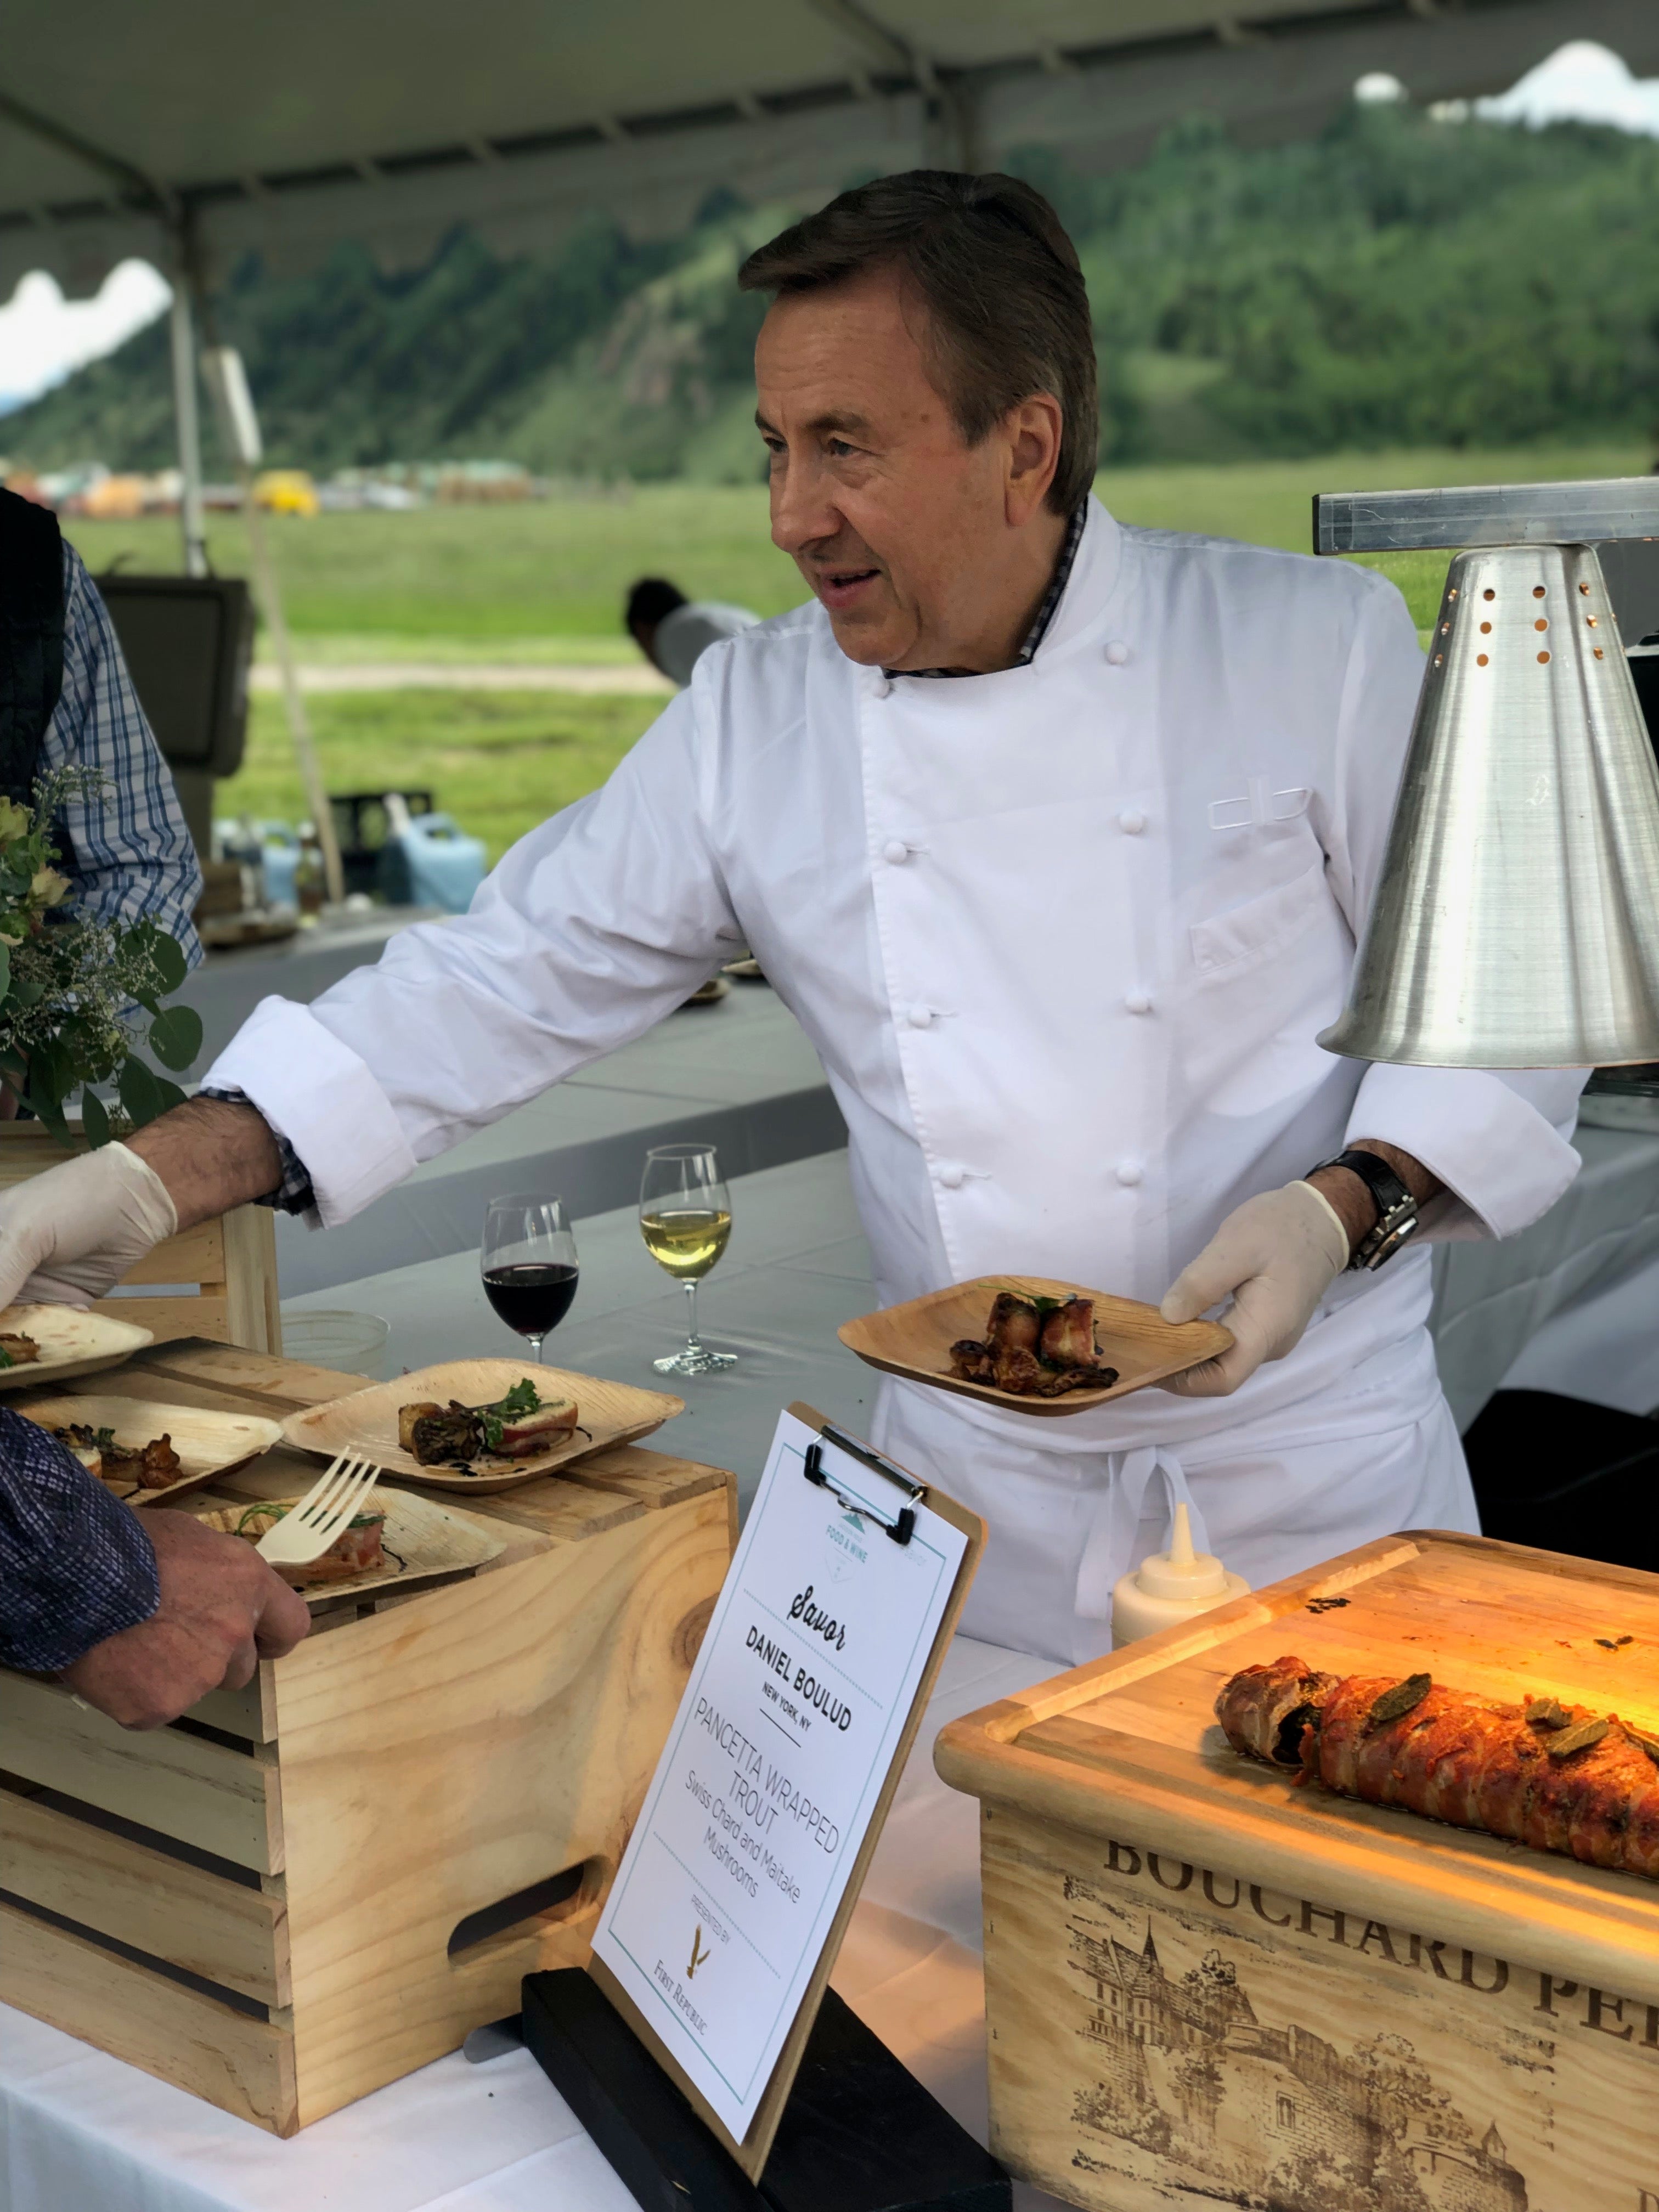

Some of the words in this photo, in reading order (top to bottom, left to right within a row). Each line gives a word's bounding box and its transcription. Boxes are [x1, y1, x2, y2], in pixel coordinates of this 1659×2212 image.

[826, 1525, 844, 1545] FOOD
[850, 1542, 868, 1564] WINE
[786, 1585, 845, 1651] Savor
[746, 1625, 792, 1682] DANIEL
[793, 1667, 851, 1731] BOULUD
[762, 1681, 780, 1703] NEW
[779, 1696, 799, 1725] YORK,
[799, 1715, 811, 1731] NY
[694, 1697, 763, 1782] PANCETTA
[765, 1764, 839, 1853] WRAPPED
[729, 1770, 778, 1835] TROUT
[686, 1770, 712, 1809] Swiss
[712, 1798, 743, 1839] Chard
[741, 1832, 763, 1861] and
[760, 1849, 800, 1903] Maitake
[703, 1825, 759, 1898] Mushrooms
[691, 1894, 723, 1937] PRESENTED
[721, 1929, 730, 1946] BY
[1103, 1839, 1509, 1994] BOUCHARD
